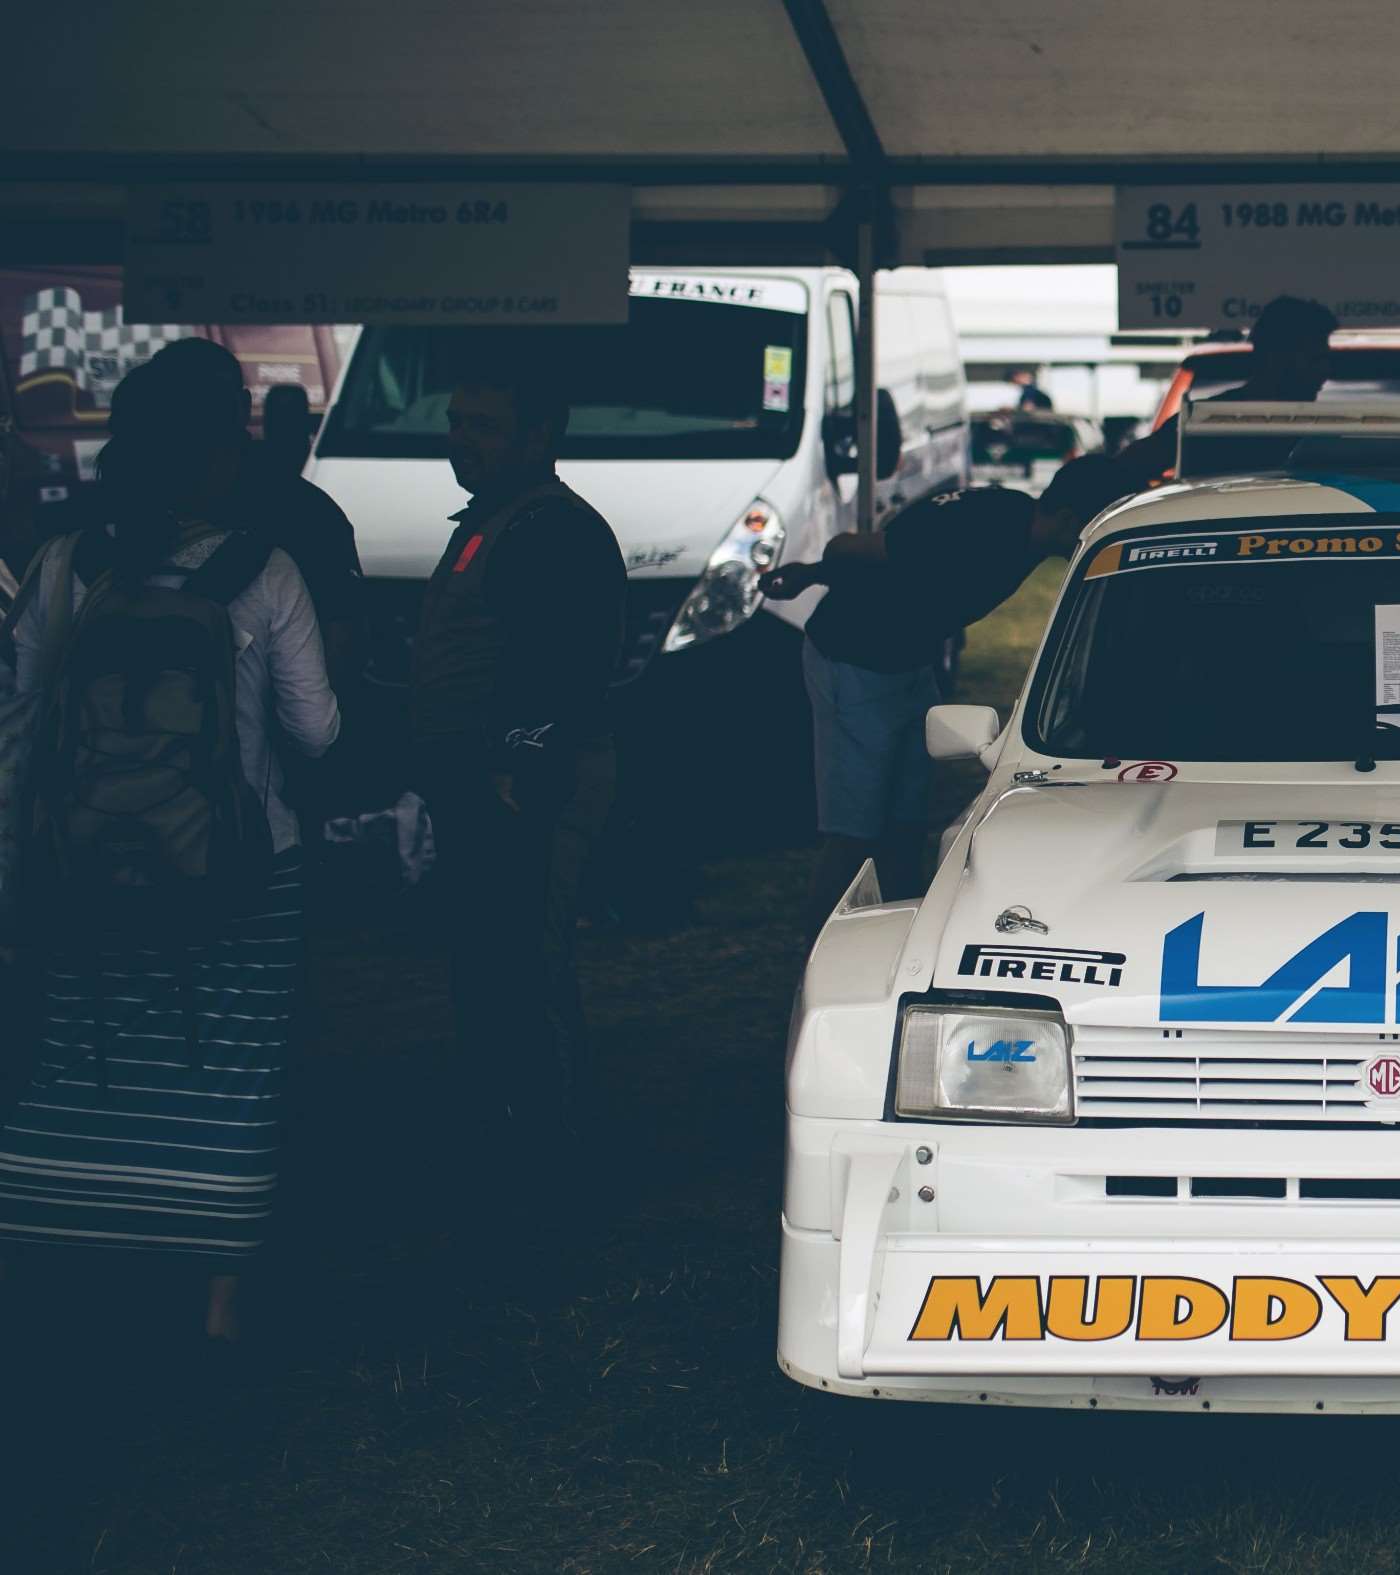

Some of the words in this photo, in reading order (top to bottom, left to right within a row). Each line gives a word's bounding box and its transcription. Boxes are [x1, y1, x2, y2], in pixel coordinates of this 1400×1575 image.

[309, 199, 359, 224] MG
[366, 199, 447, 224] Metro
[1146, 202, 1201, 240] 84
[1220, 201, 1291, 228] 1988
[1295, 202, 1347, 228] MG
[653, 279, 764, 301] FRANCE
[1149, 296, 1183, 319] 10
[1128, 542, 1219, 562] PIRELLI
[1236, 534, 1384, 557] Promo
[1136, 764, 1165, 780] E
[1242, 821, 1278, 849] E
[957, 943, 1127, 987] PIRELLI
